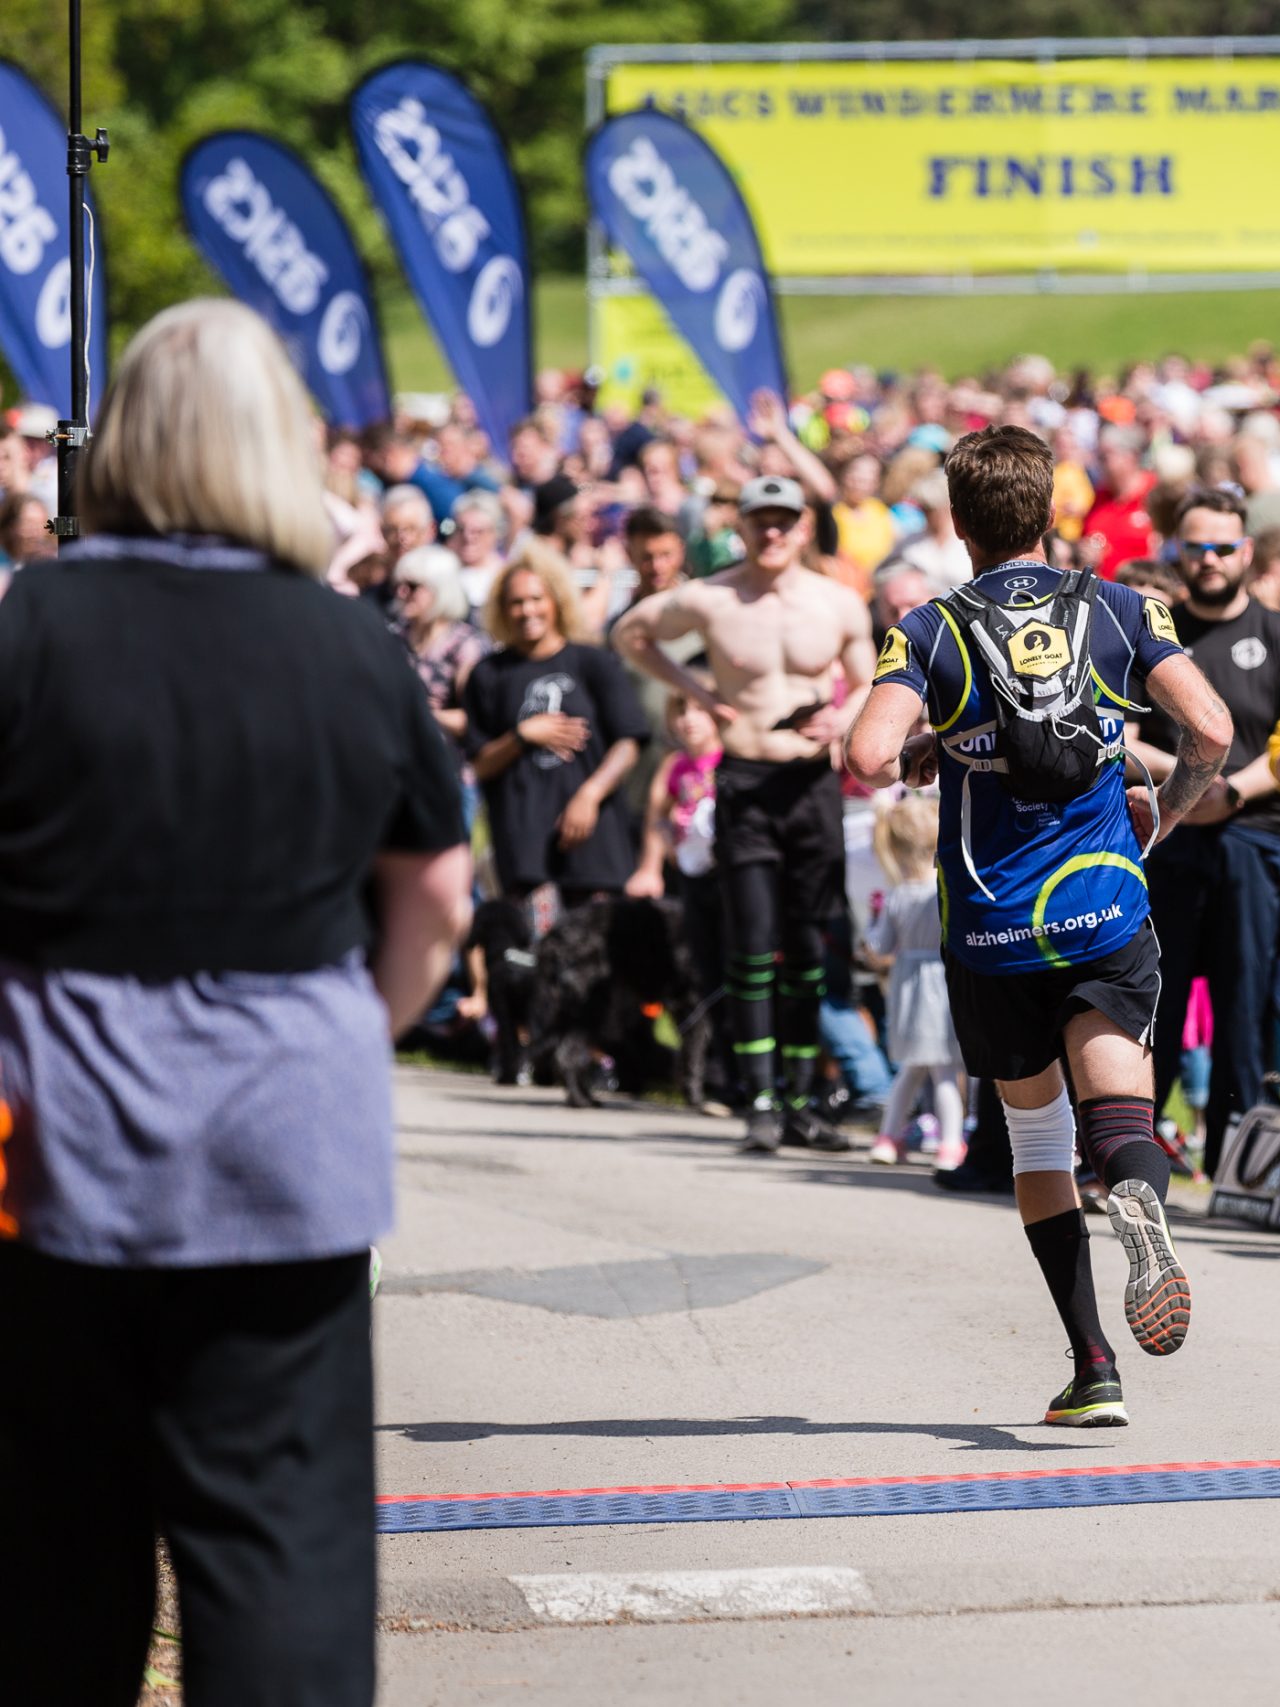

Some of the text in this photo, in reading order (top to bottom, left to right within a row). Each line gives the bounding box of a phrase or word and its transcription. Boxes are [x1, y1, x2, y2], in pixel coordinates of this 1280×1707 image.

[787, 85, 1149, 118] WINDERMERE
[925, 155, 1175, 197] FINISH
[993, 560, 1038, 572] RMOUR
[1020, 652, 1063, 667] LONELY GOAT
[966, 903, 1124, 947] alzheimers.org.uk
